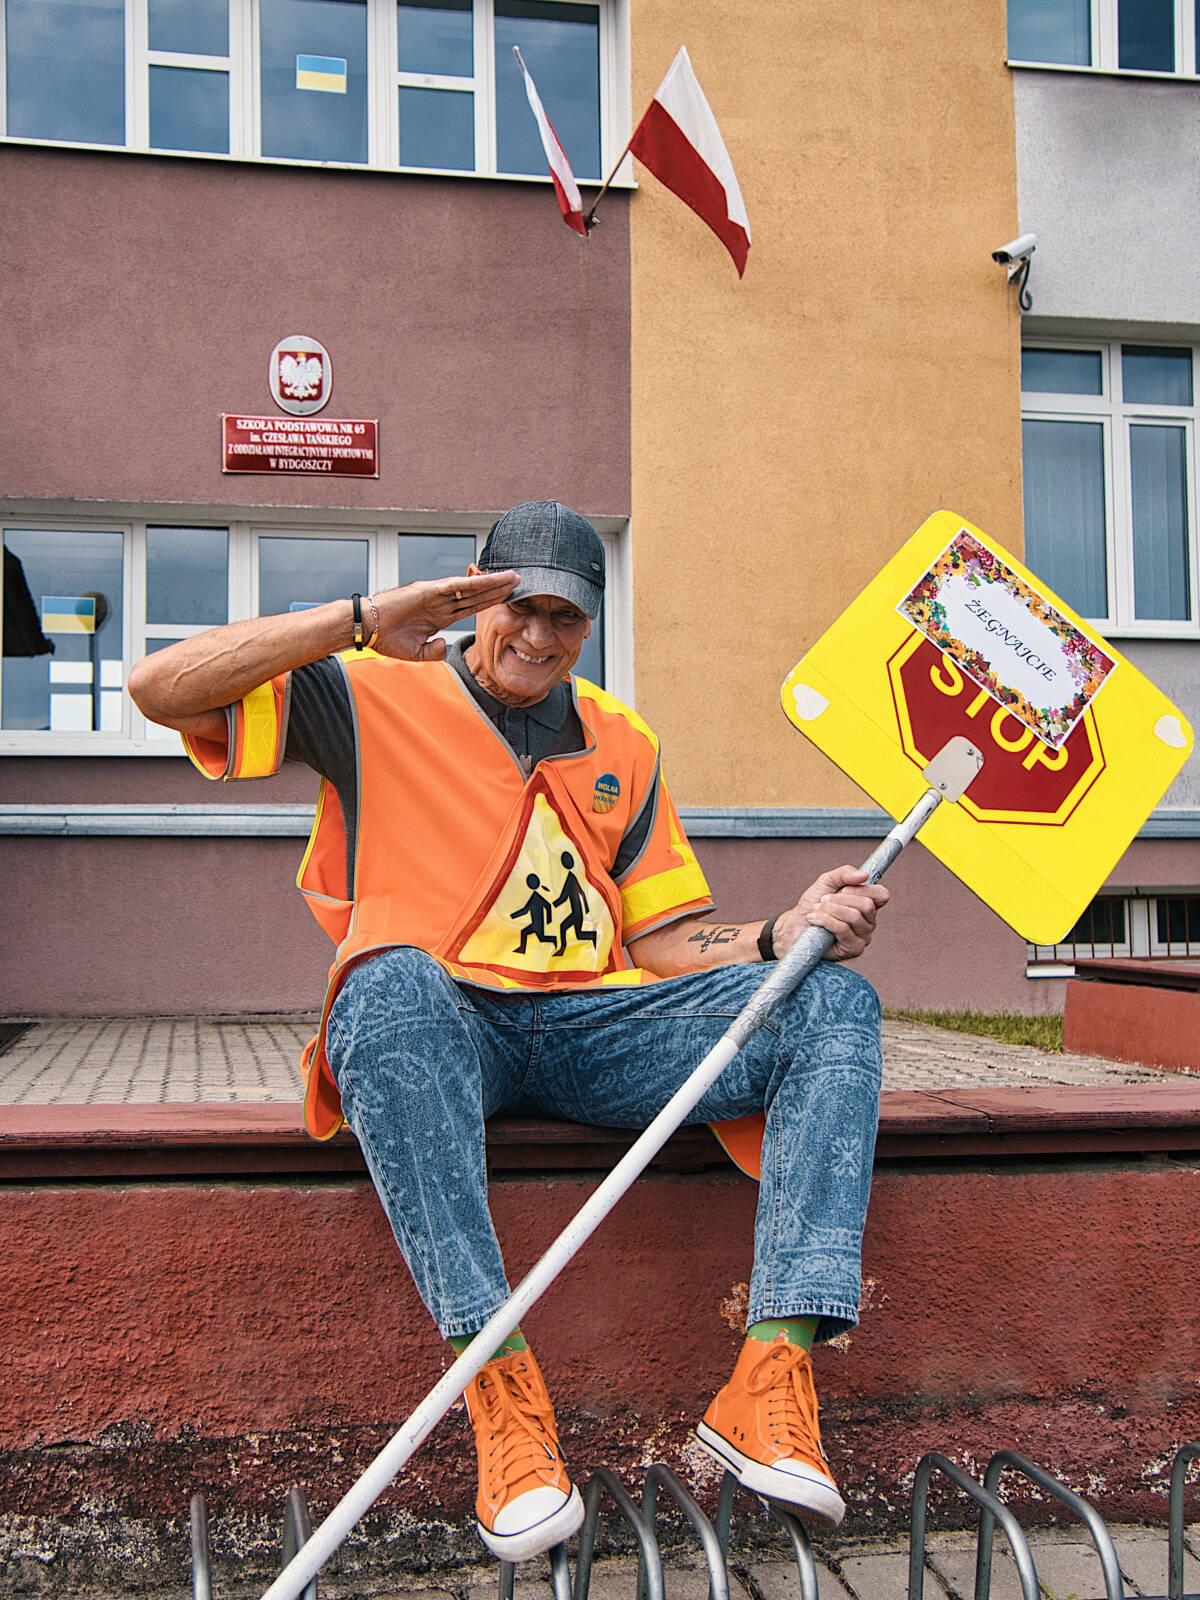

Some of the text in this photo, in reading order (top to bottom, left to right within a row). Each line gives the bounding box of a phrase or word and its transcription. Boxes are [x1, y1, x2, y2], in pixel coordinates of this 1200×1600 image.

[236, 419, 365, 434] SZKOŁA PODSTAWOWA NR 65
[262, 432, 304, 444] CZESŁAWA
[305, 432, 352, 446] TAŃSKIEGO
[228, 444, 233, 454] Z
[234, 444, 274, 455] ODDZIAŁAMI
[275, 445, 328, 458] INTEGRACYJNYMI
[332, 448, 373, 460] SPORTOWYMI
[269, 458, 333, 471] W BYDGOSZCZY
[964, 599, 1057, 682] ŻEGNAJCIE
[598, 782, 618, 793] WOLNA
